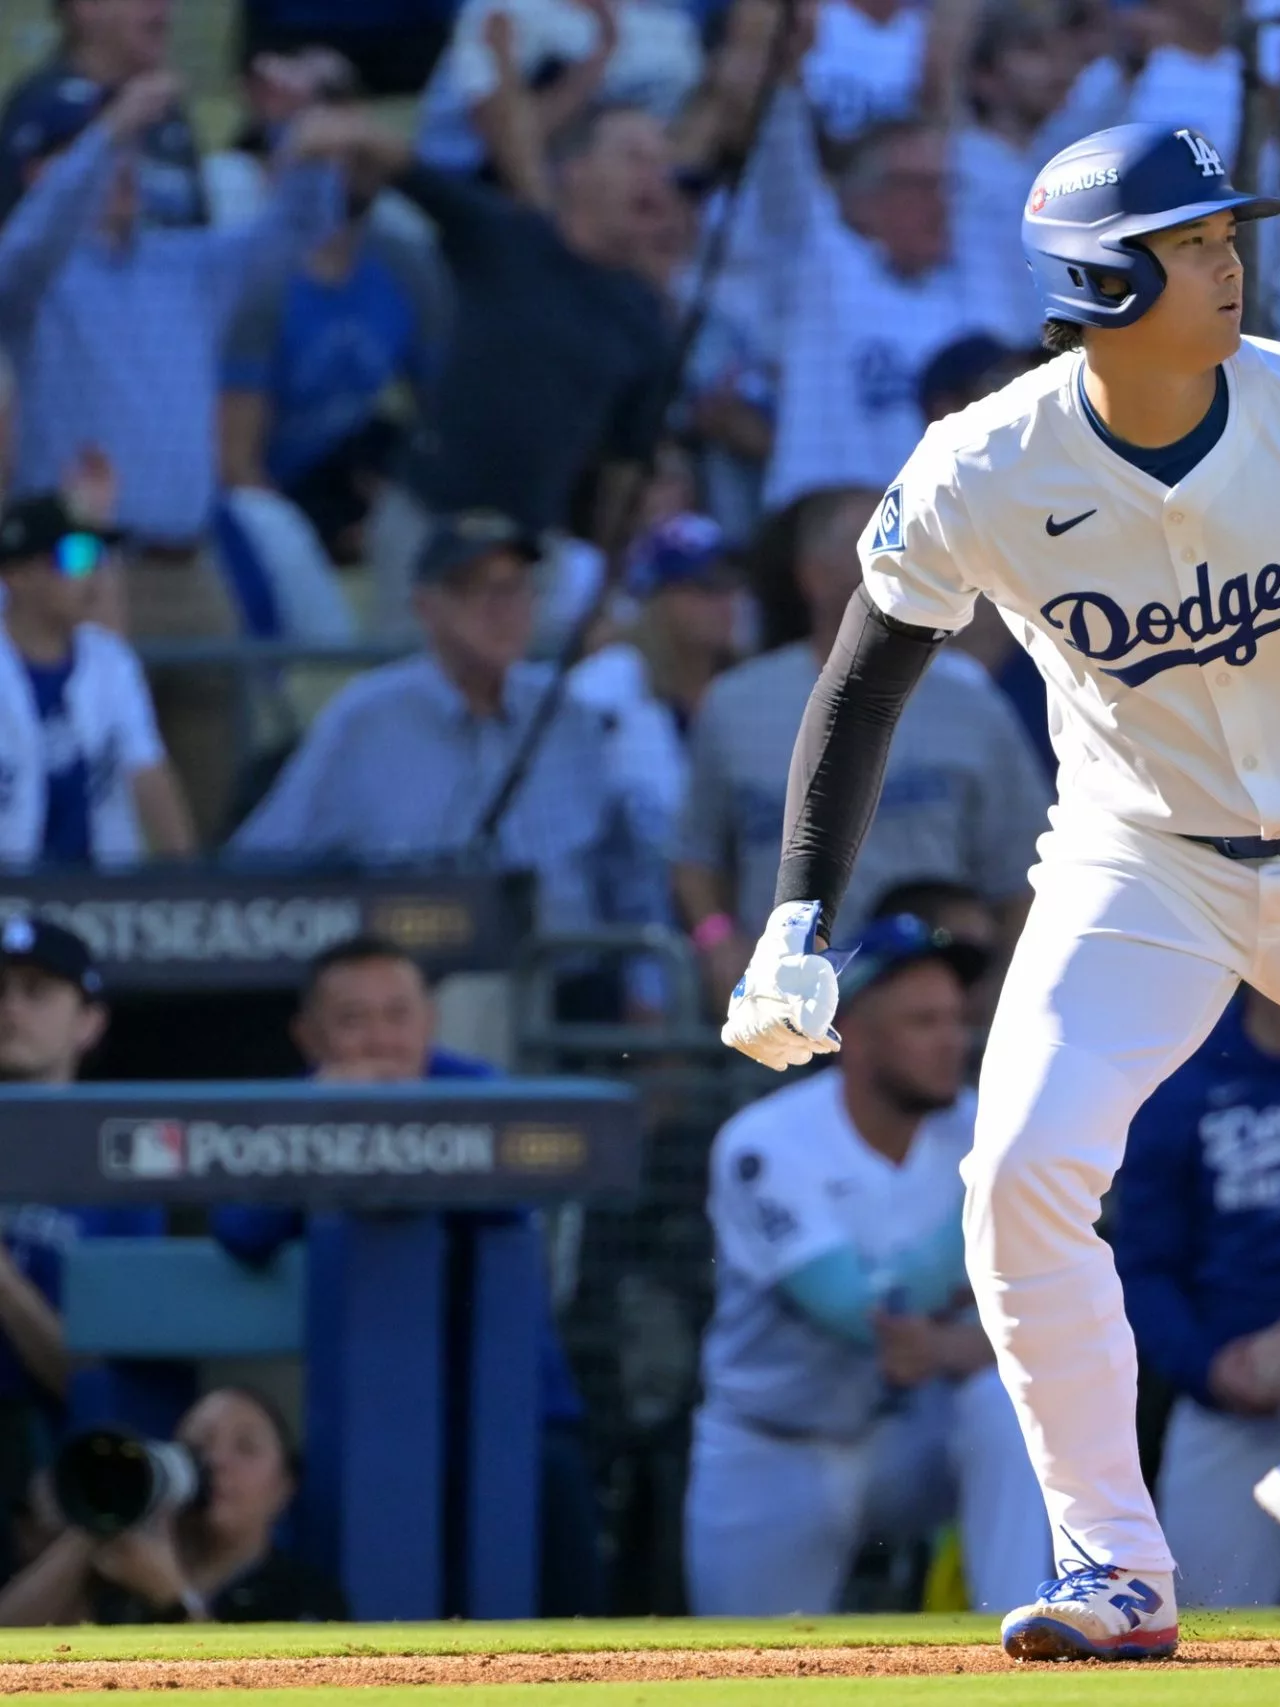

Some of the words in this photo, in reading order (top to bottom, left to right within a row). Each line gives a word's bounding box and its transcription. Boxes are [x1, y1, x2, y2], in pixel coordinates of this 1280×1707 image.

[1174, 129, 1225, 177] LA
[1044, 167, 1119, 201] STRAUSS
[187, 1122, 495, 1176] POSTSEASON
